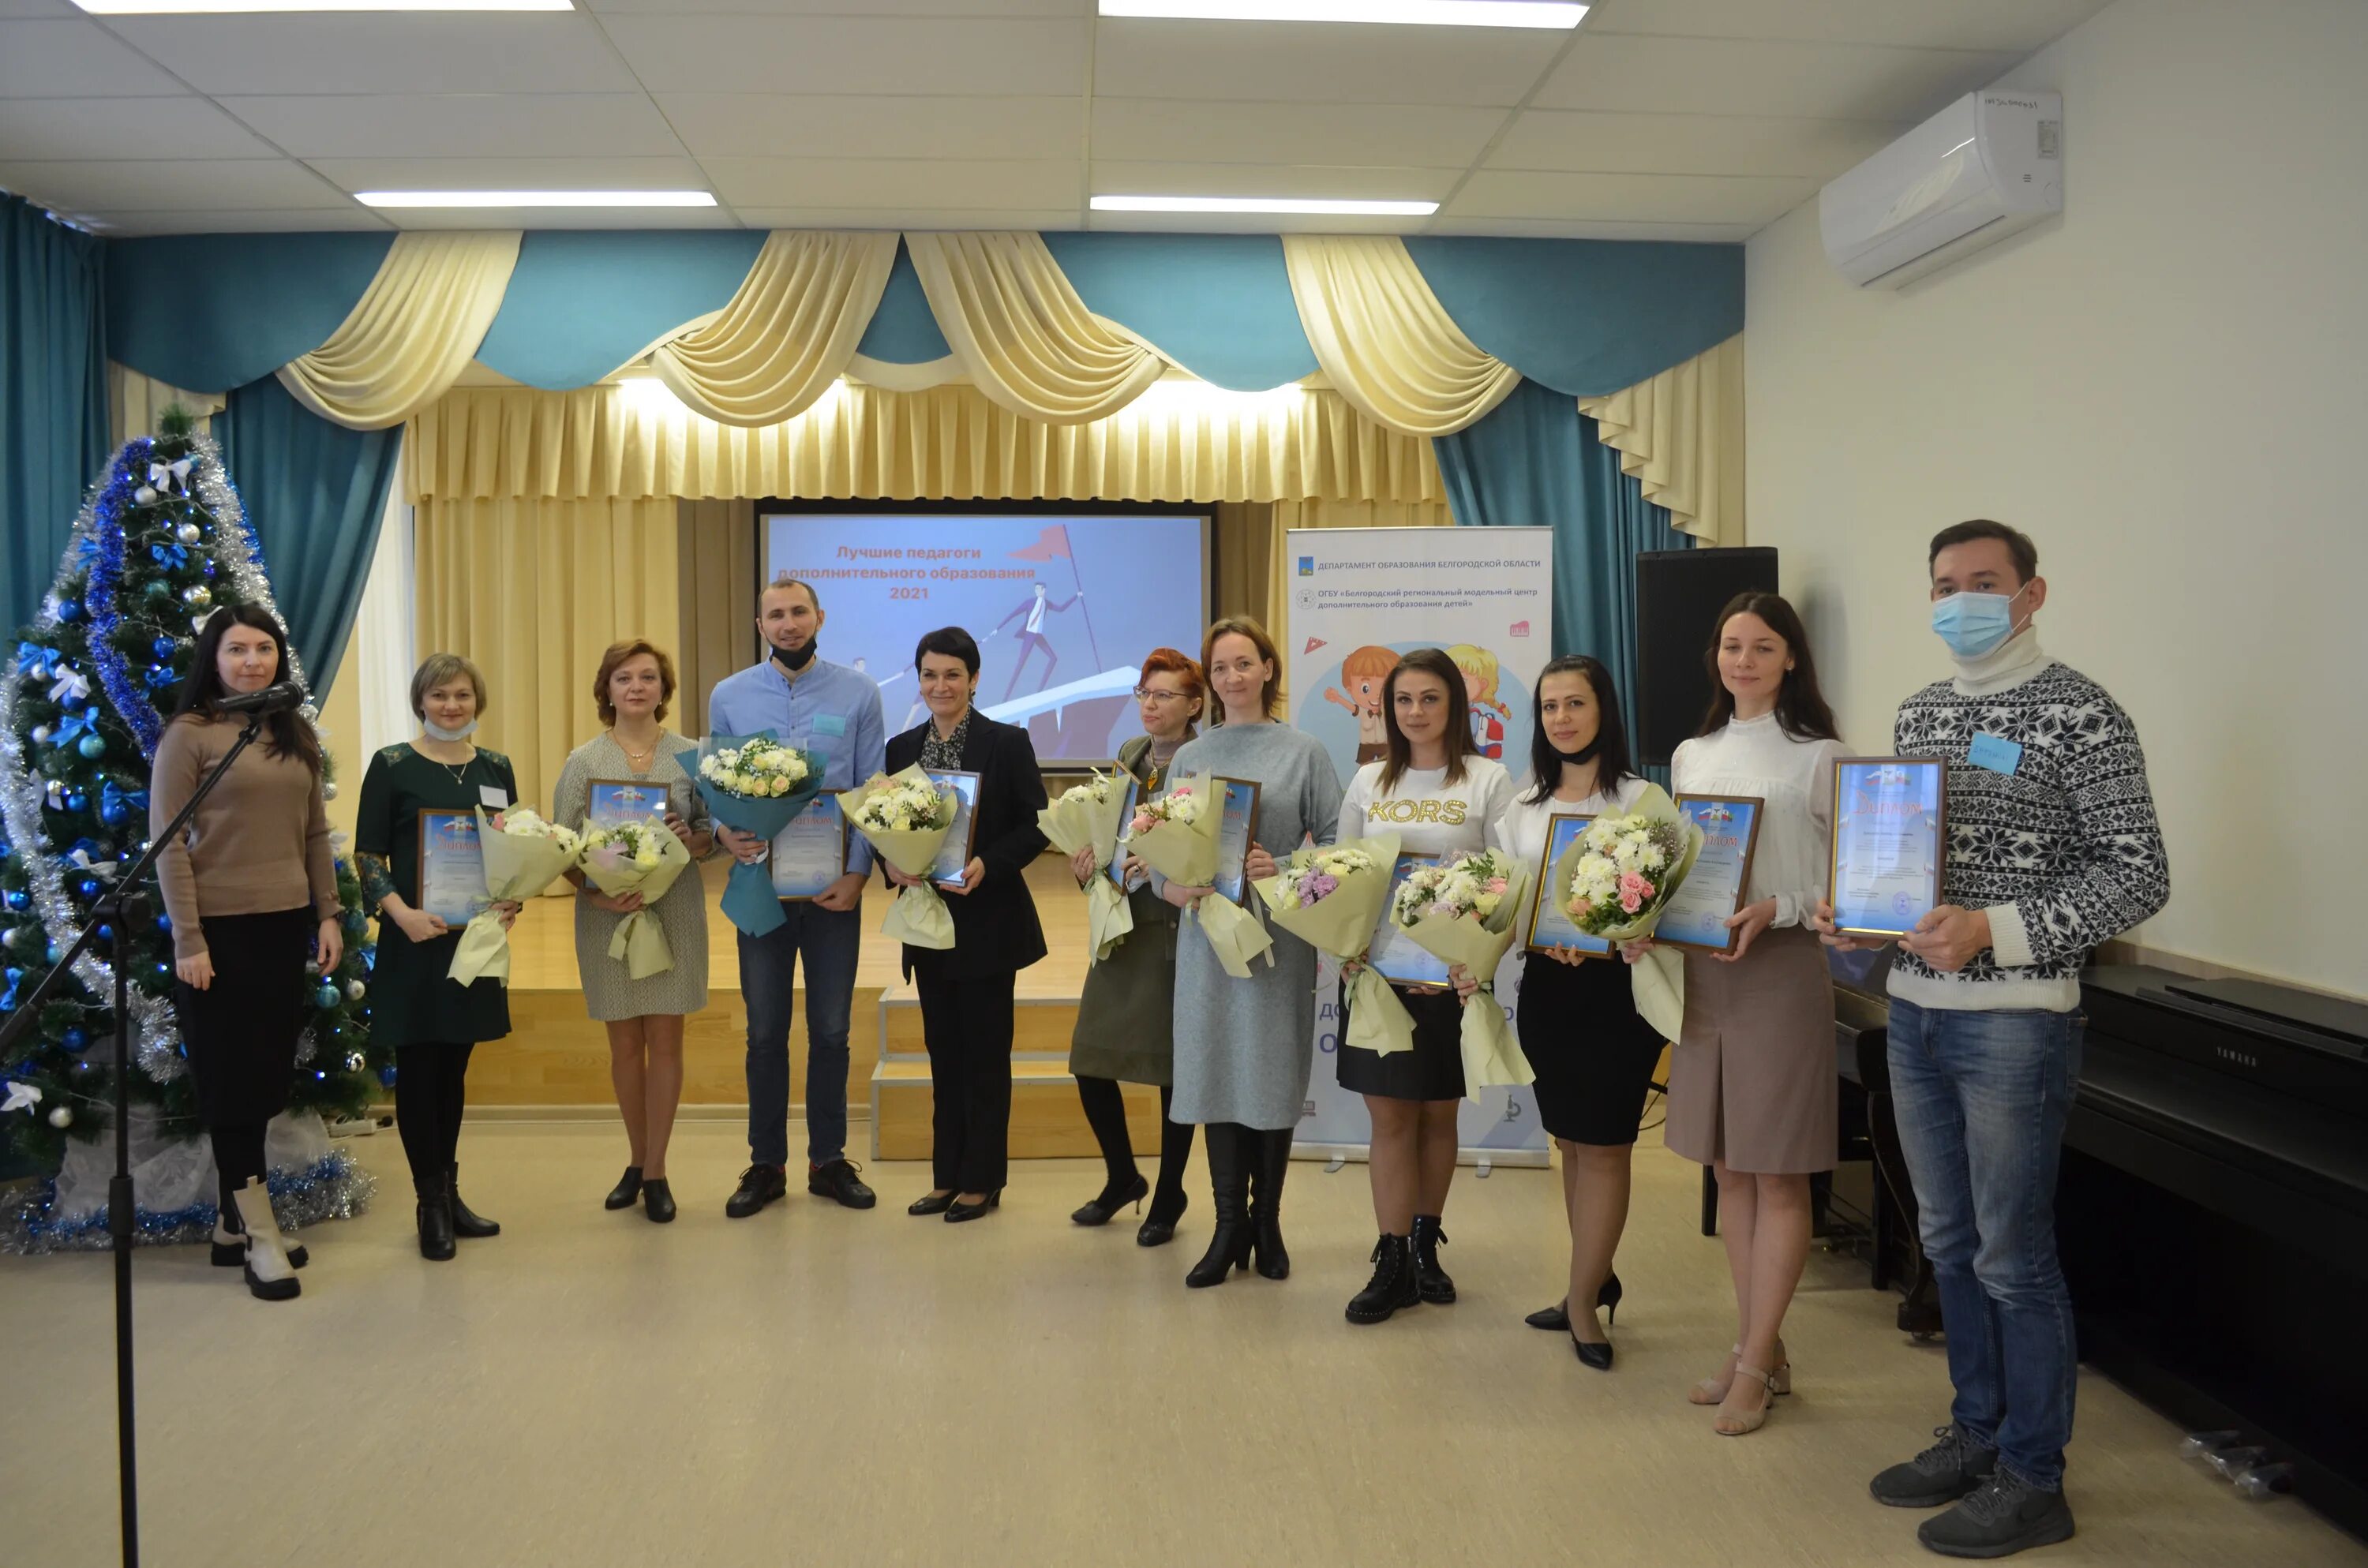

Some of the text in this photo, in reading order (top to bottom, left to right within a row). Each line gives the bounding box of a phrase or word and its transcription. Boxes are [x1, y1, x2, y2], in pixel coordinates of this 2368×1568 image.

[836, 545, 981, 560] Лучшие педагоги
[1317, 562, 1377, 571] ДЕПАРТАМЕНТ
[1438, 559, 1501, 569] БЕЛГОРОДСКОЙ
[778, 567, 1036, 581] дополнительного образования
[889, 587, 929, 600] 2021
[1339, 589, 1401, 598] «Белгородский
[1403, 589, 1463, 598] региональный
[1464, 589, 1512, 597] модельный
[1317, 600, 1474, 610] дополнительного образования детей»
[1853, 789, 1923, 815] Диплом
[1368, 799, 1467, 826] KORS
[2216, 1046, 2257, 1068] YAMAHA
